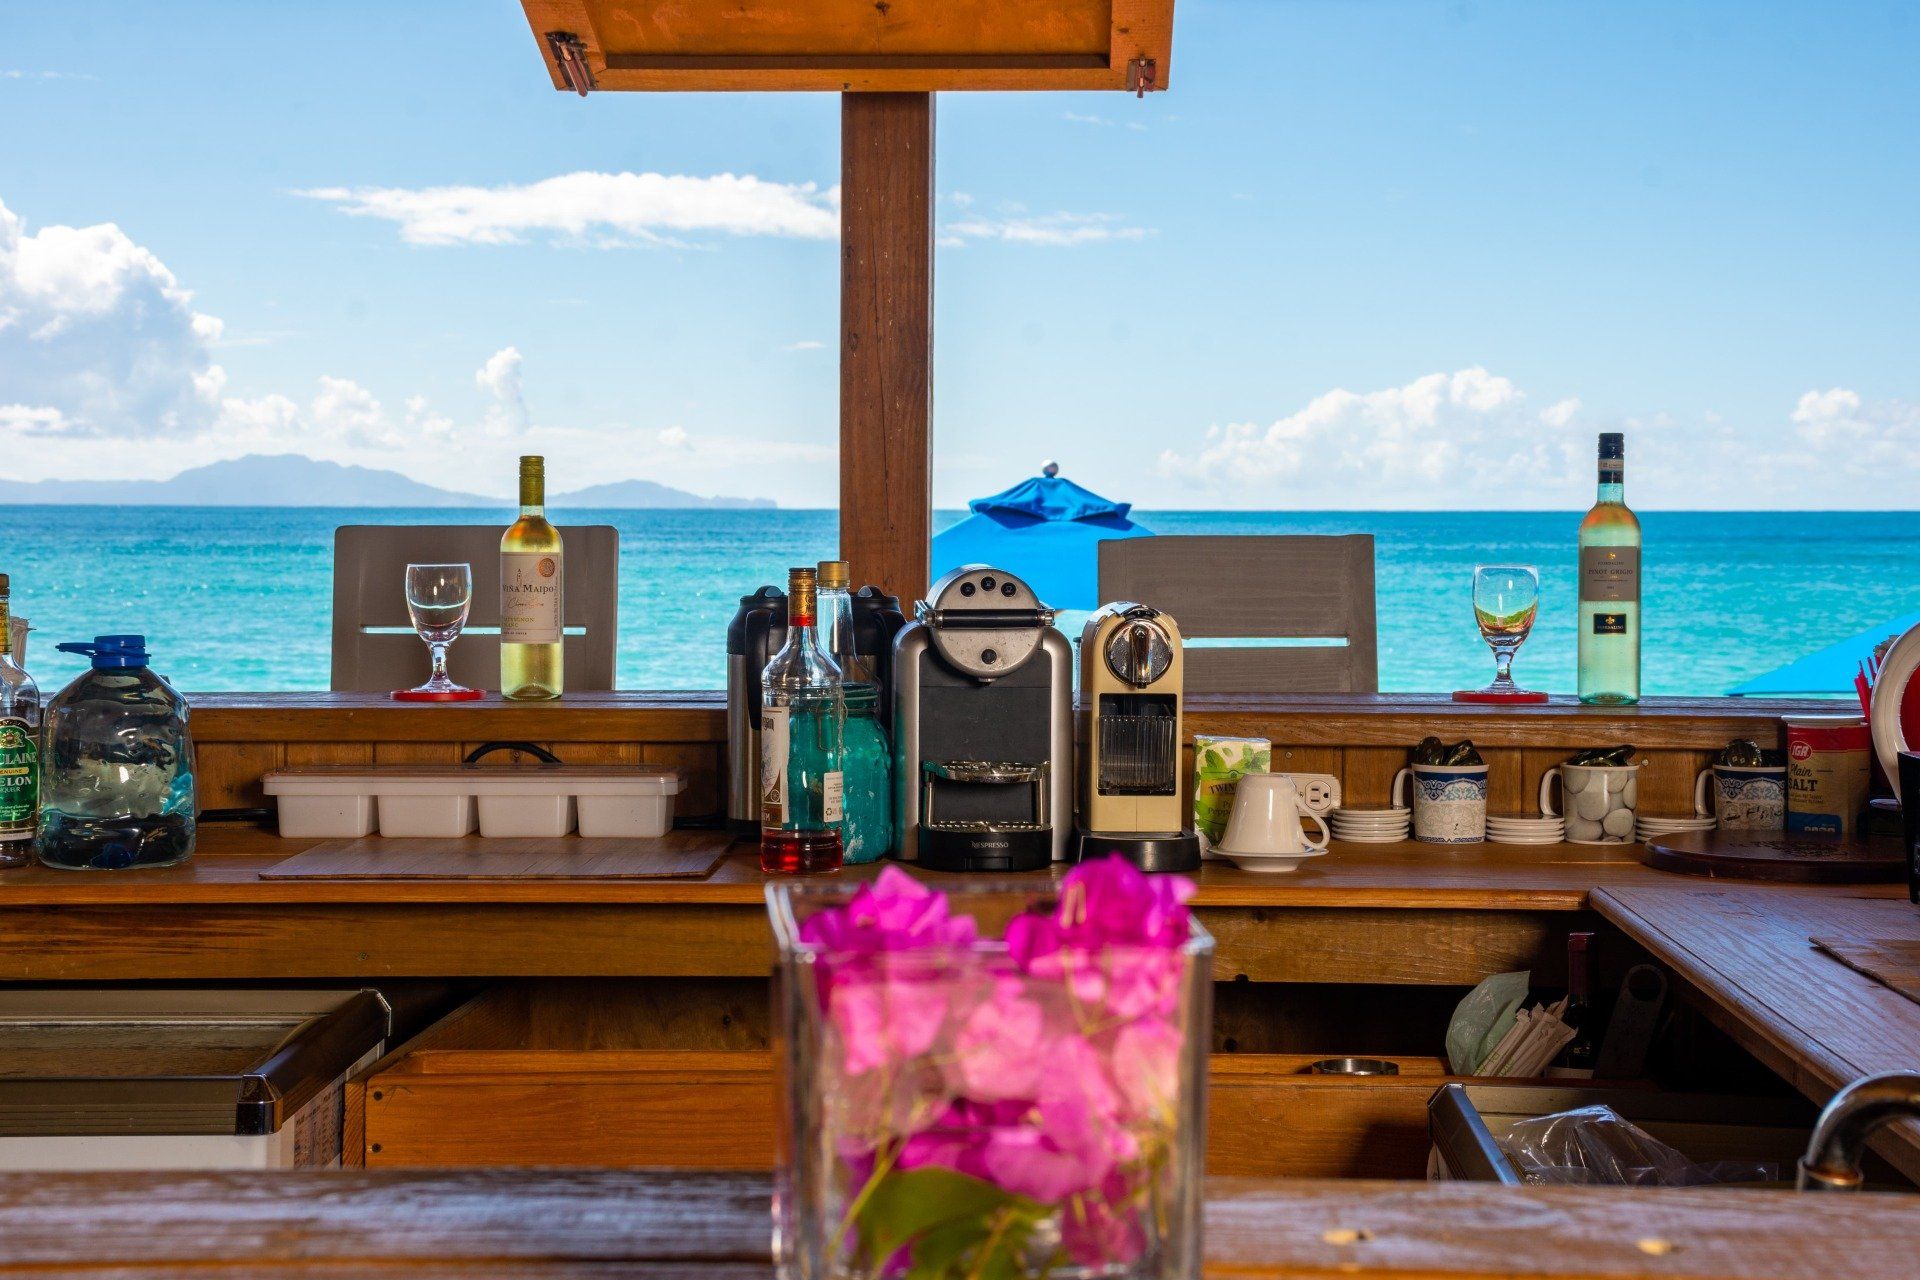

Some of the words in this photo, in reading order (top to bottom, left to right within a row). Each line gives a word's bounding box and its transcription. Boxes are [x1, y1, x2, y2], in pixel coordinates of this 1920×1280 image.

[0, 752, 37, 765] ULAINE
[0, 776, 33, 787] ELON
[1788, 778, 1818, 791] SALT
[1208, 783, 1237, 794] TWIN
